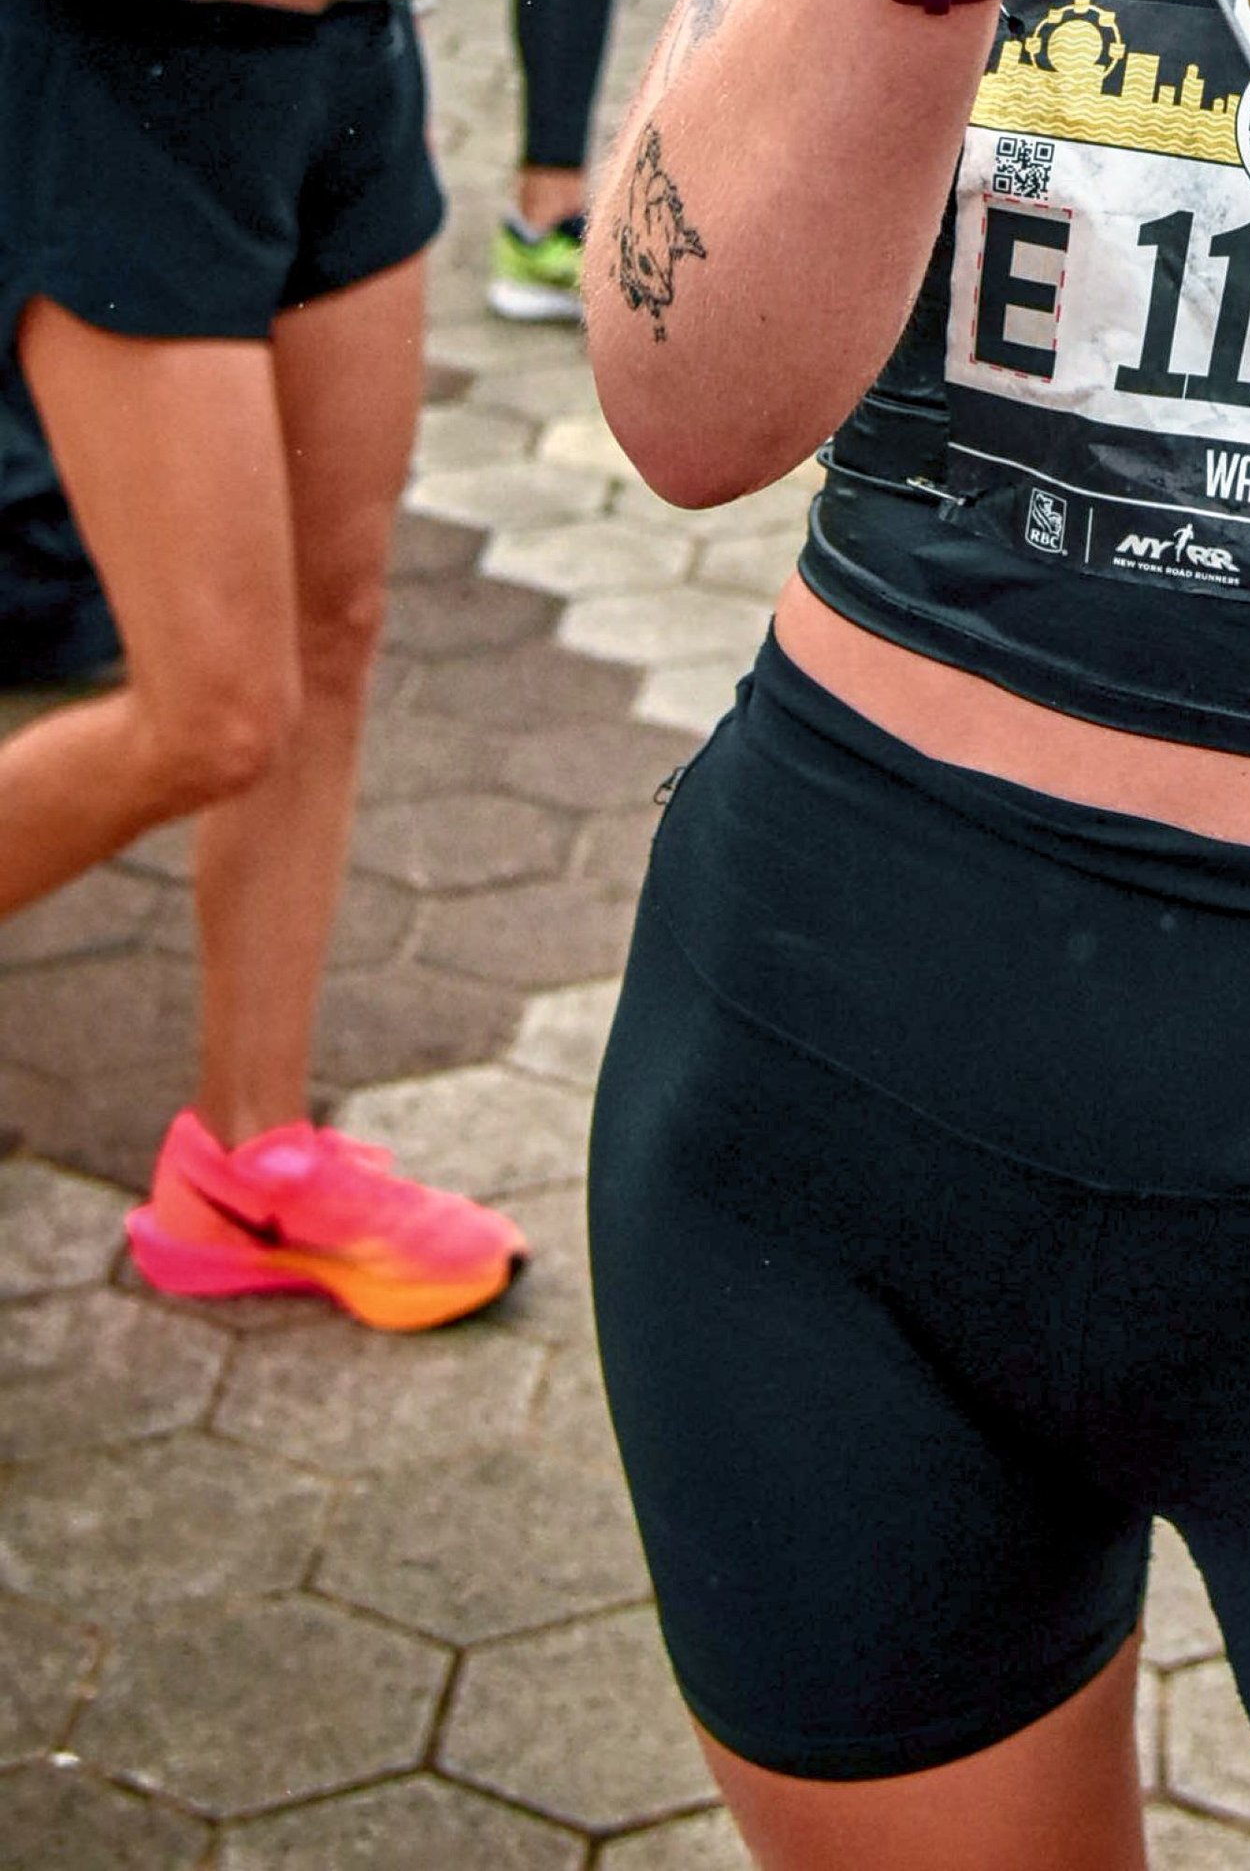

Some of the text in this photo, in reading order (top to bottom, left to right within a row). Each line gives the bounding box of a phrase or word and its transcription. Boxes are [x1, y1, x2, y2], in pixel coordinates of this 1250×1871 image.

[974, 207, 1071, 380] E
[1030, 527, 1059, 549] RBC
[1112, 556, 1241, 587] NEW YORK ROAD RUNNERS
